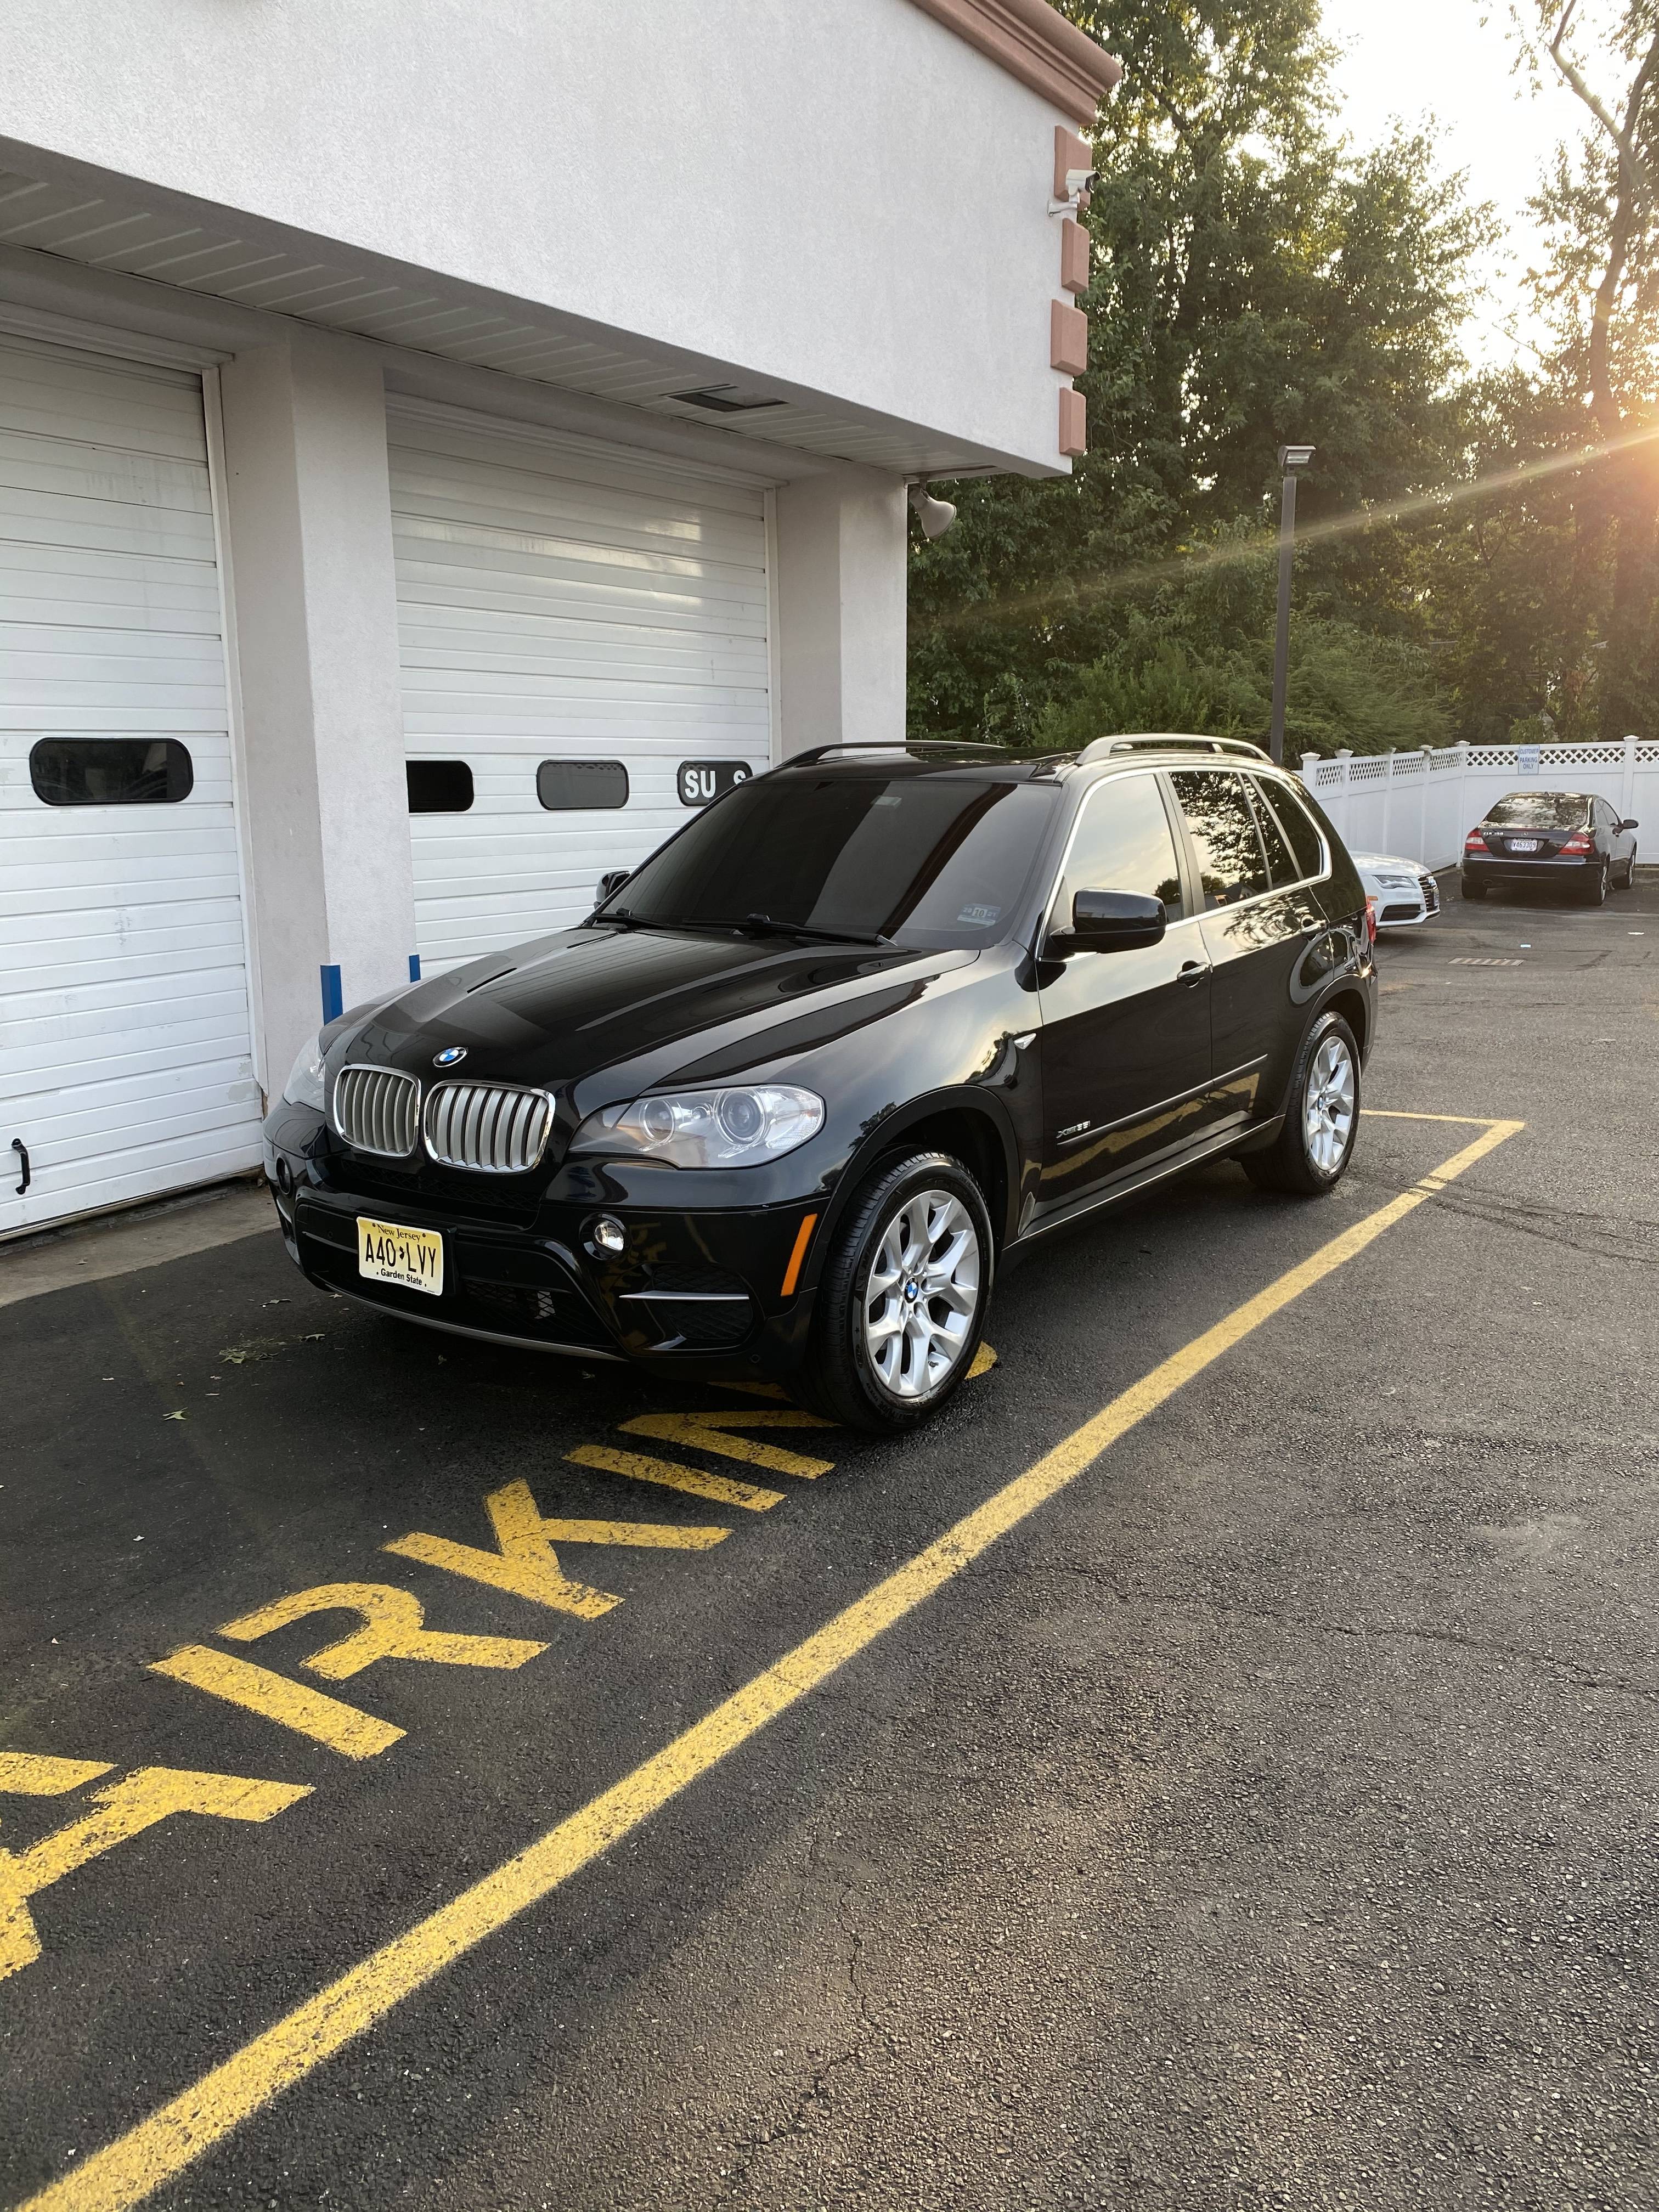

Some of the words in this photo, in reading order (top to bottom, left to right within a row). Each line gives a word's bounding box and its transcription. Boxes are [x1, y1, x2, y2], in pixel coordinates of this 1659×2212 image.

[685, 770, 716, 798] SU
[377, 1224, 394, 1236] New
[396, 1228, 421, 1243] Jersey
[381, 1268, 405, 1280] Garden
[406, 1274, 422, 1285] State
